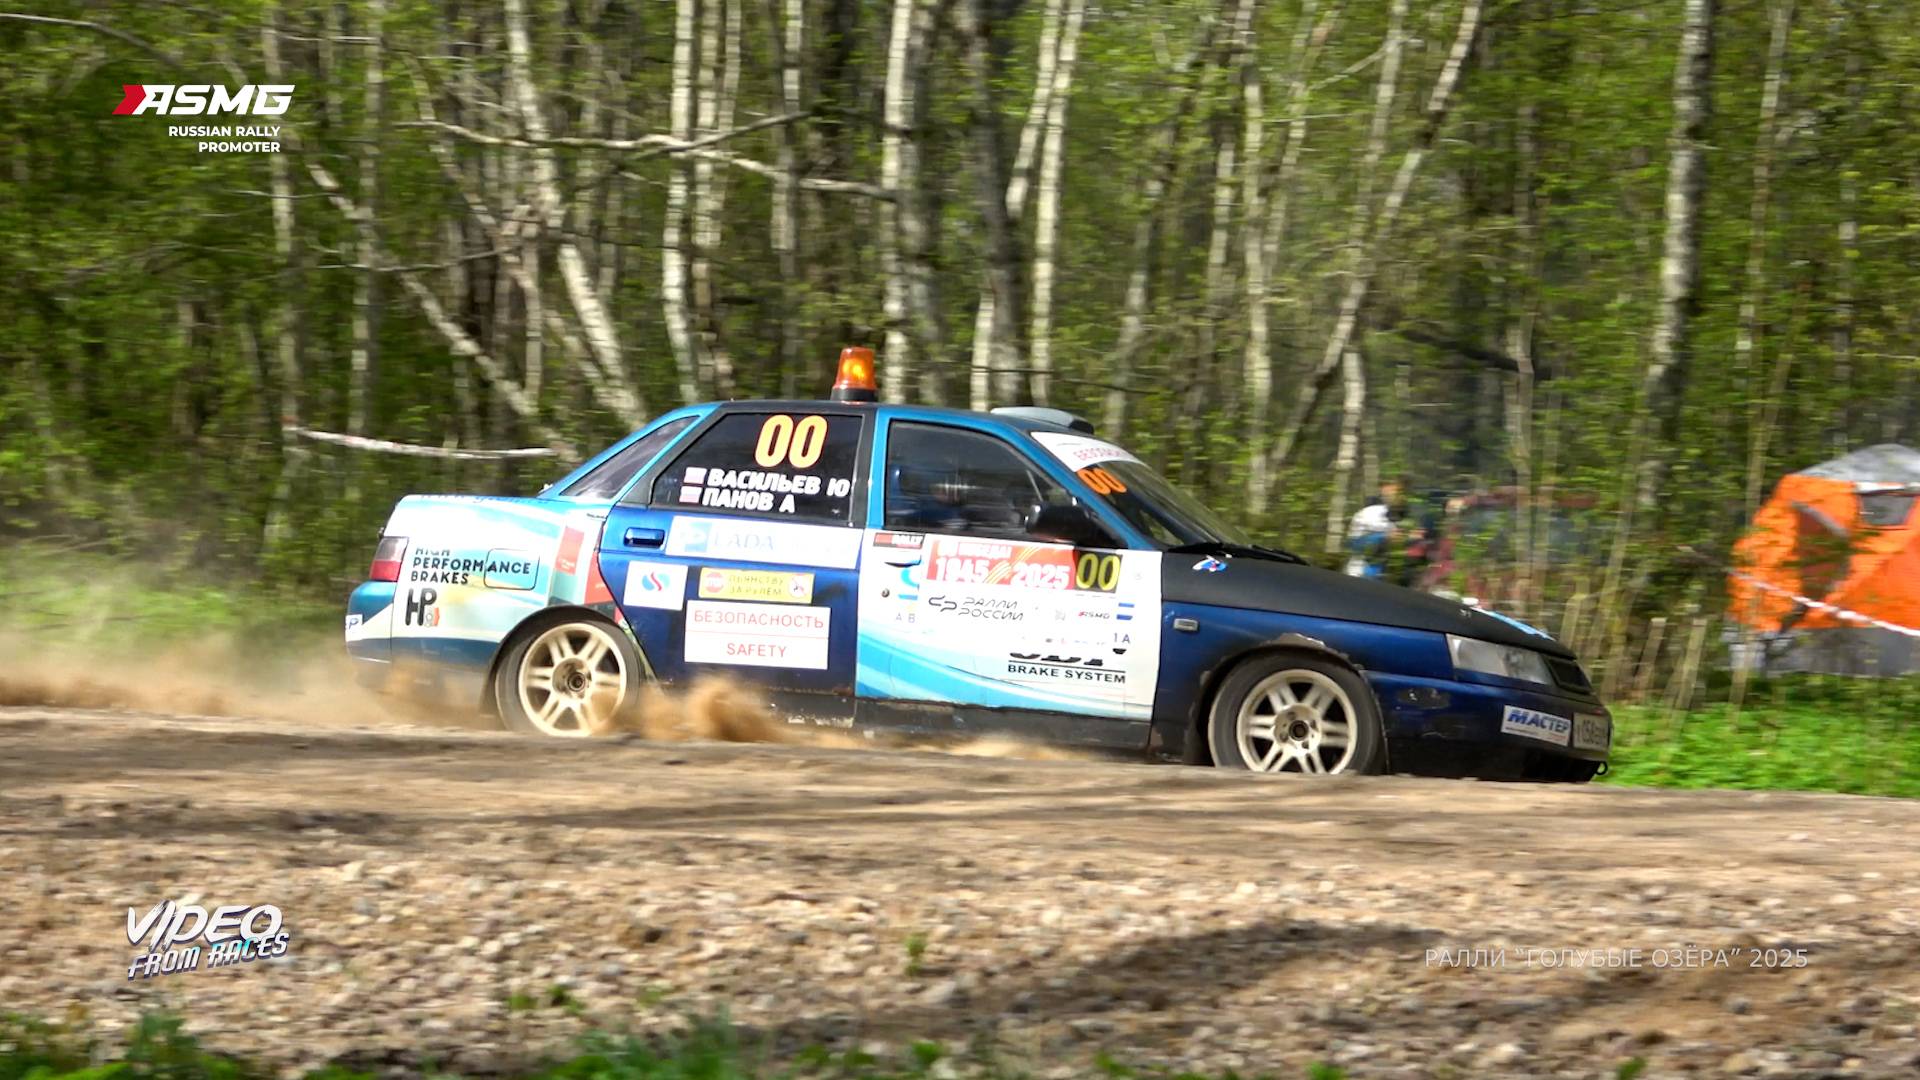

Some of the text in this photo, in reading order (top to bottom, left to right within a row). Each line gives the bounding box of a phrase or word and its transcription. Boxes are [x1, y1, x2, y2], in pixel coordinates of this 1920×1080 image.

[754, 414, 828, 468] 00
[707, 468, 850, 497] ВАСИЛЬЕВ Ю
[1077, 467, 1127, 496] 00
[702, 487, 775, 511] ПАНОВ
[410, 570, 469, 585] BRAKES
[412, 556, 531, 575] PERFORMANCE
[1011, 562, 1071, 590] 2025
[1075, 552, 1121, 590] 00
[694, 609, 824, 629] БЕЗОПАСНОСТЬ
[726, 642, 787, 658] SAFETY
[1008, 664, 1126, 684] BRAKE SYSTEM
[1507, 709, 1570, 733] МАСТЕР
